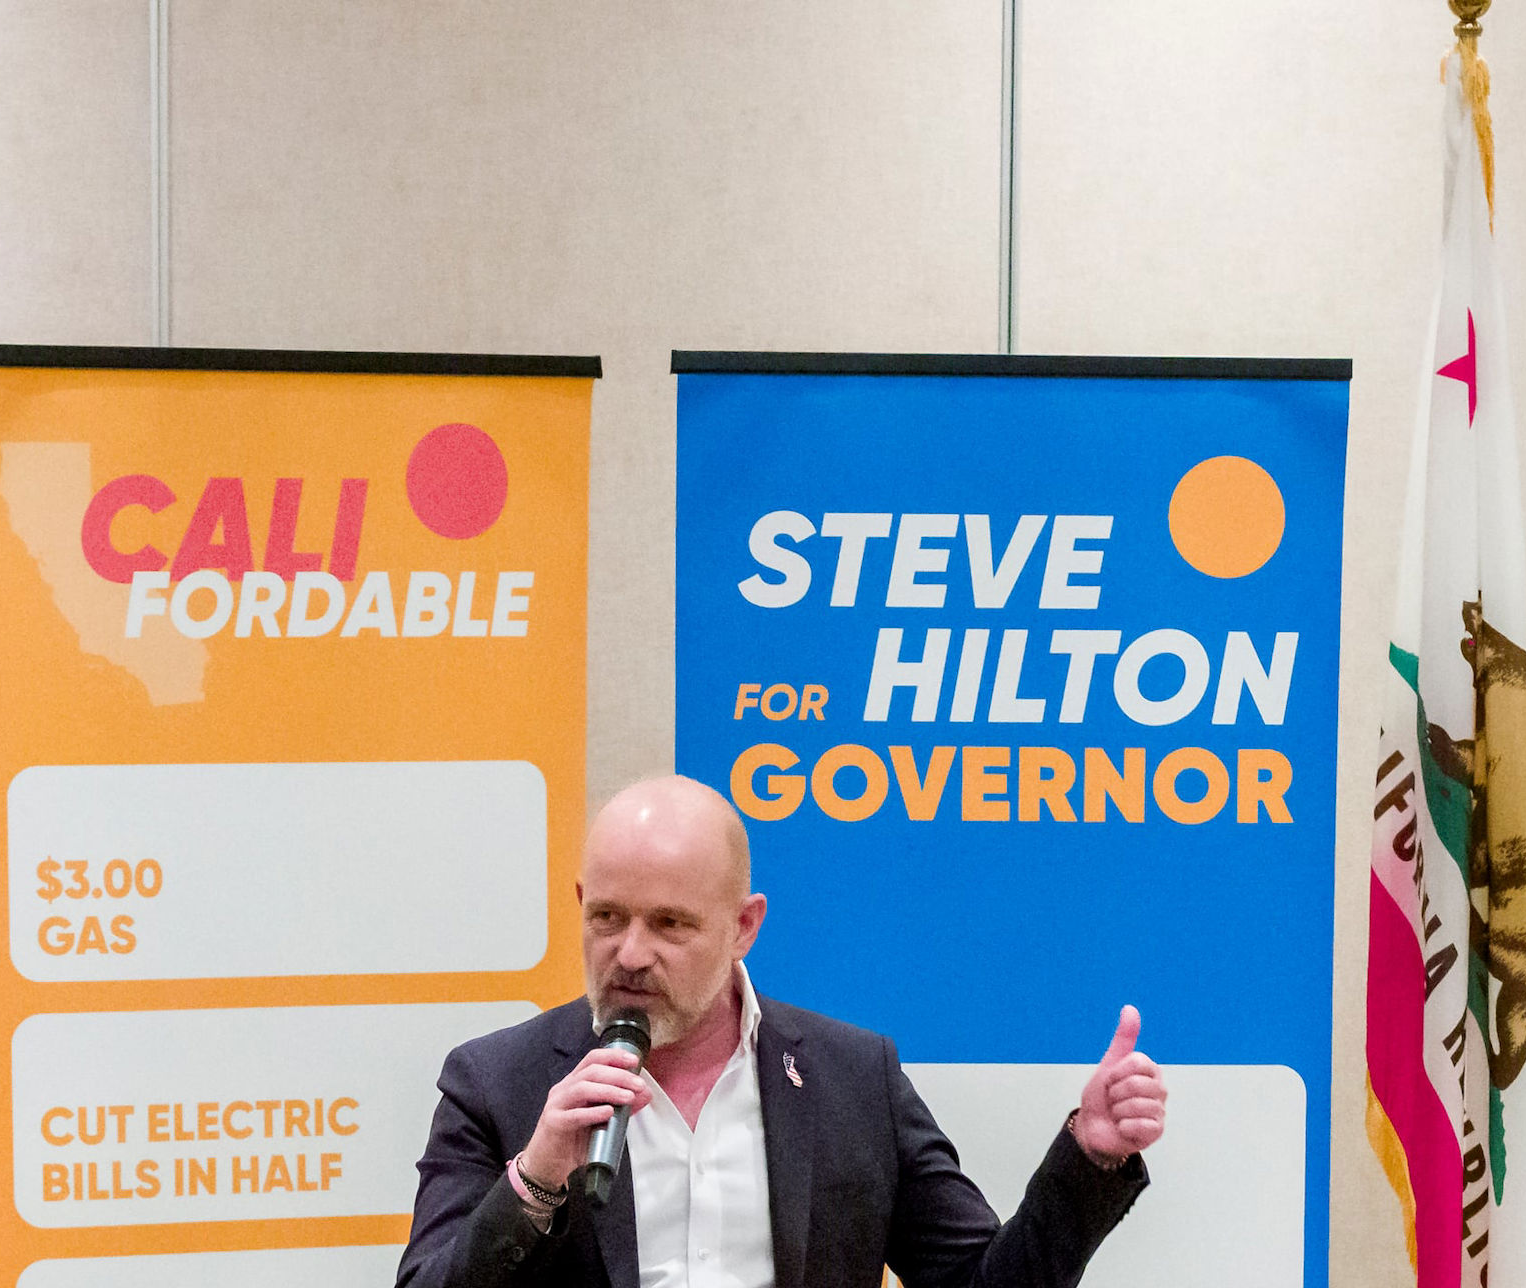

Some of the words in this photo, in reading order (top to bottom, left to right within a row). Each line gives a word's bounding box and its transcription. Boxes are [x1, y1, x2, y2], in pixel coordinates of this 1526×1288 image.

[81, 474, 369, 583] CALI
[737, 510, 1114, 609] STEVE
[124, 570, 534, 639] FORDABLE
[734, 683, 829, 721] FOR
[863, 628, 1299, 726] HILTON
[730, 743, 1294, 825] GOVERNOR
[35, 856, 164, 904] $3.00
[36, 915, 137, 955] GAS
[40, 1104, 135, 1147] CUT
[147, 1097, 361, 1142] ELECTRIC
[42, 1158, 160, 1203] BILLS
[175, 1156, 217, 1196] IN
[232, 1153, 343, 1194] HALF
